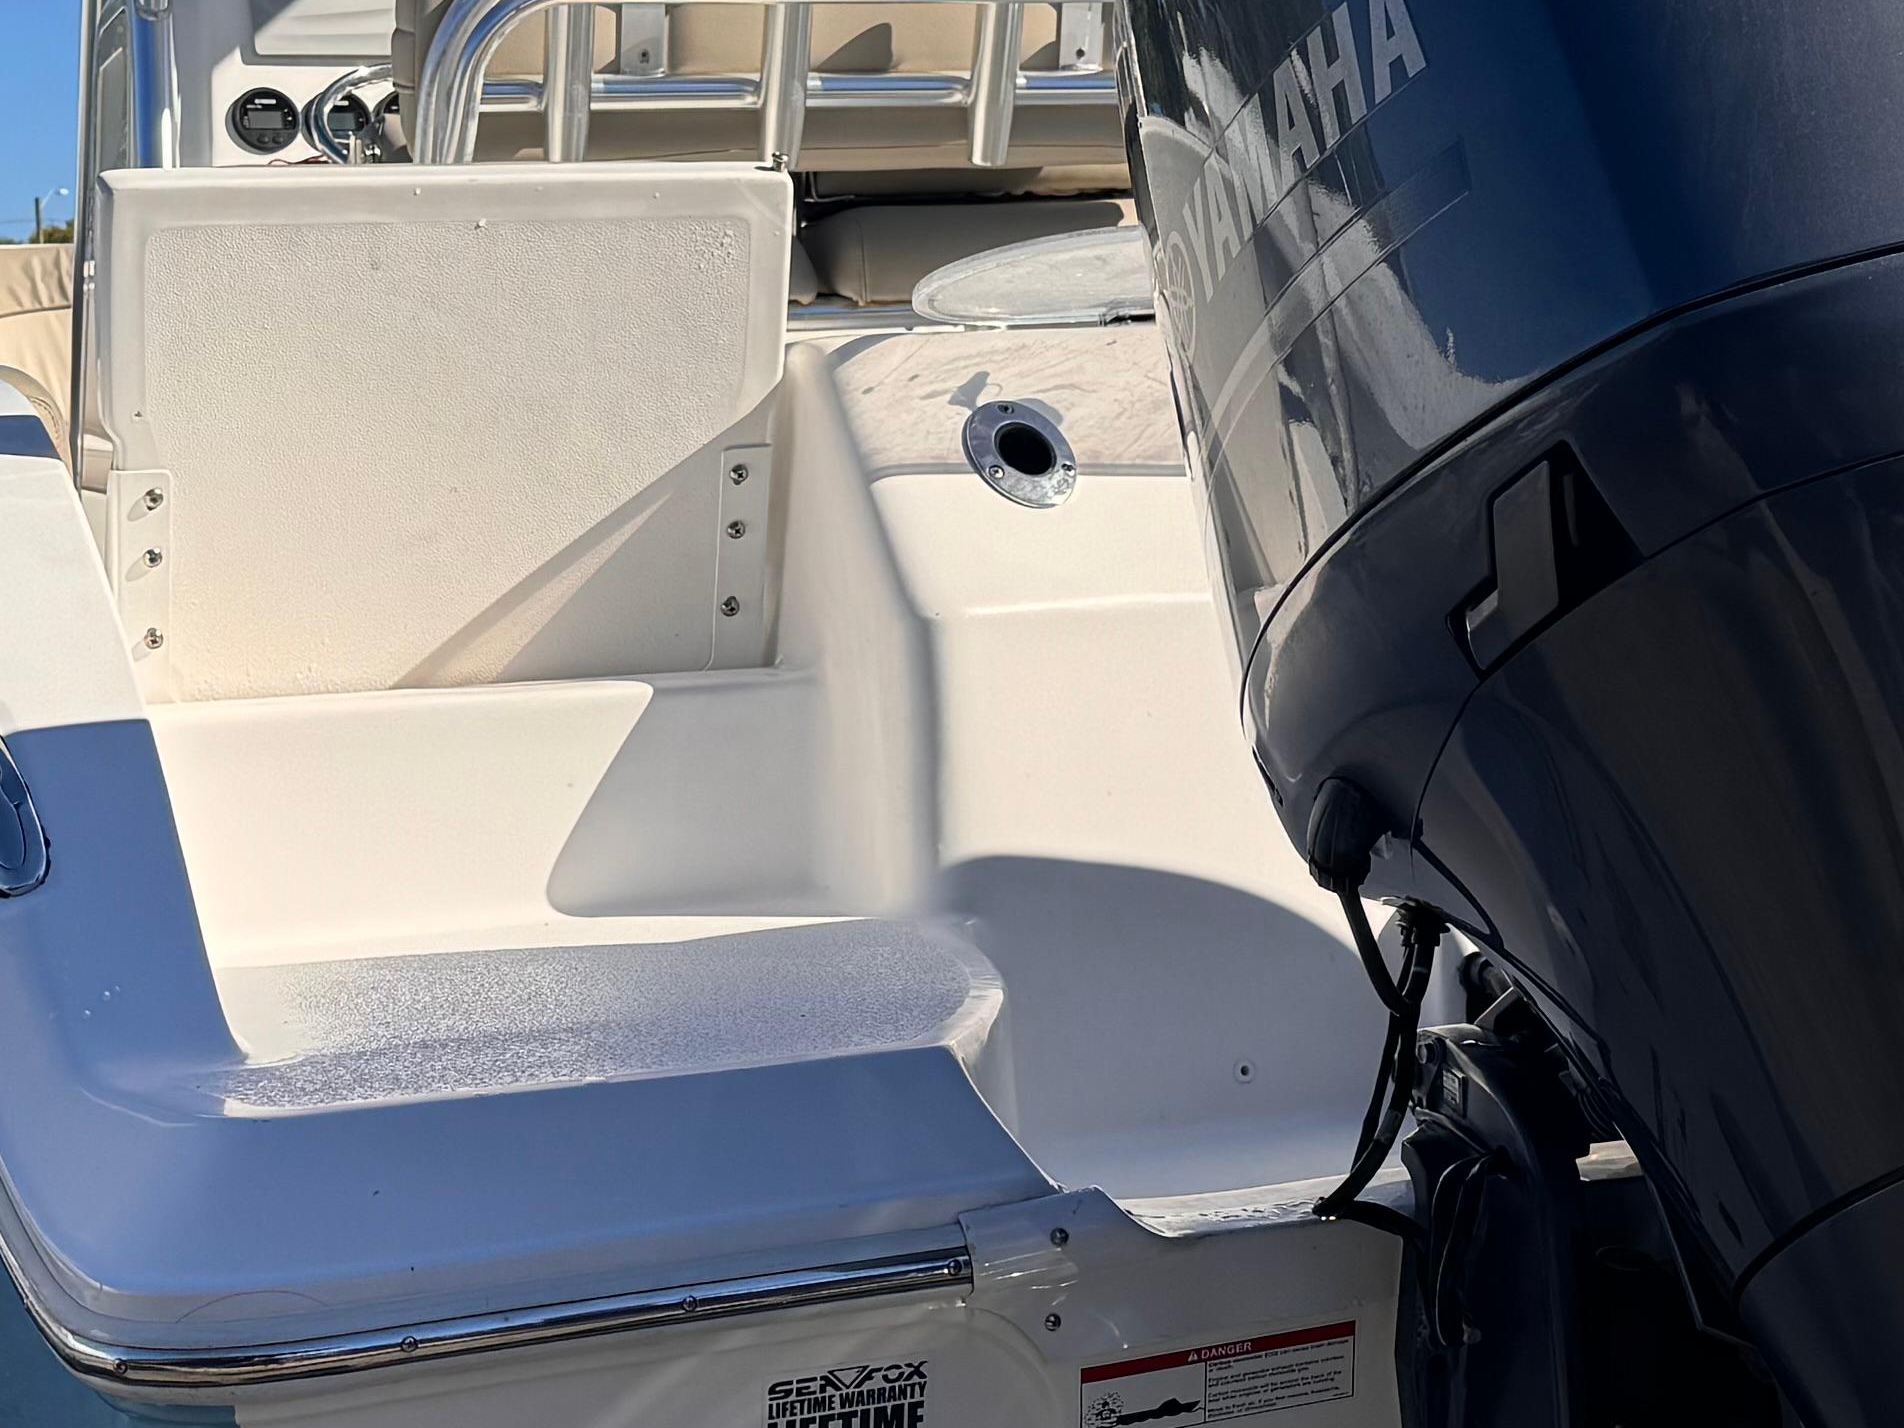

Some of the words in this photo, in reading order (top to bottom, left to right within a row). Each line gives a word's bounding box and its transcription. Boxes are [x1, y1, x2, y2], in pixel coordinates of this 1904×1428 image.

[1200, 1341, 1253, 1360] DANGER
[768, 1393, 836, 1420] LIFETIME
[838, 1380, 928, 1411] WARRANTY
